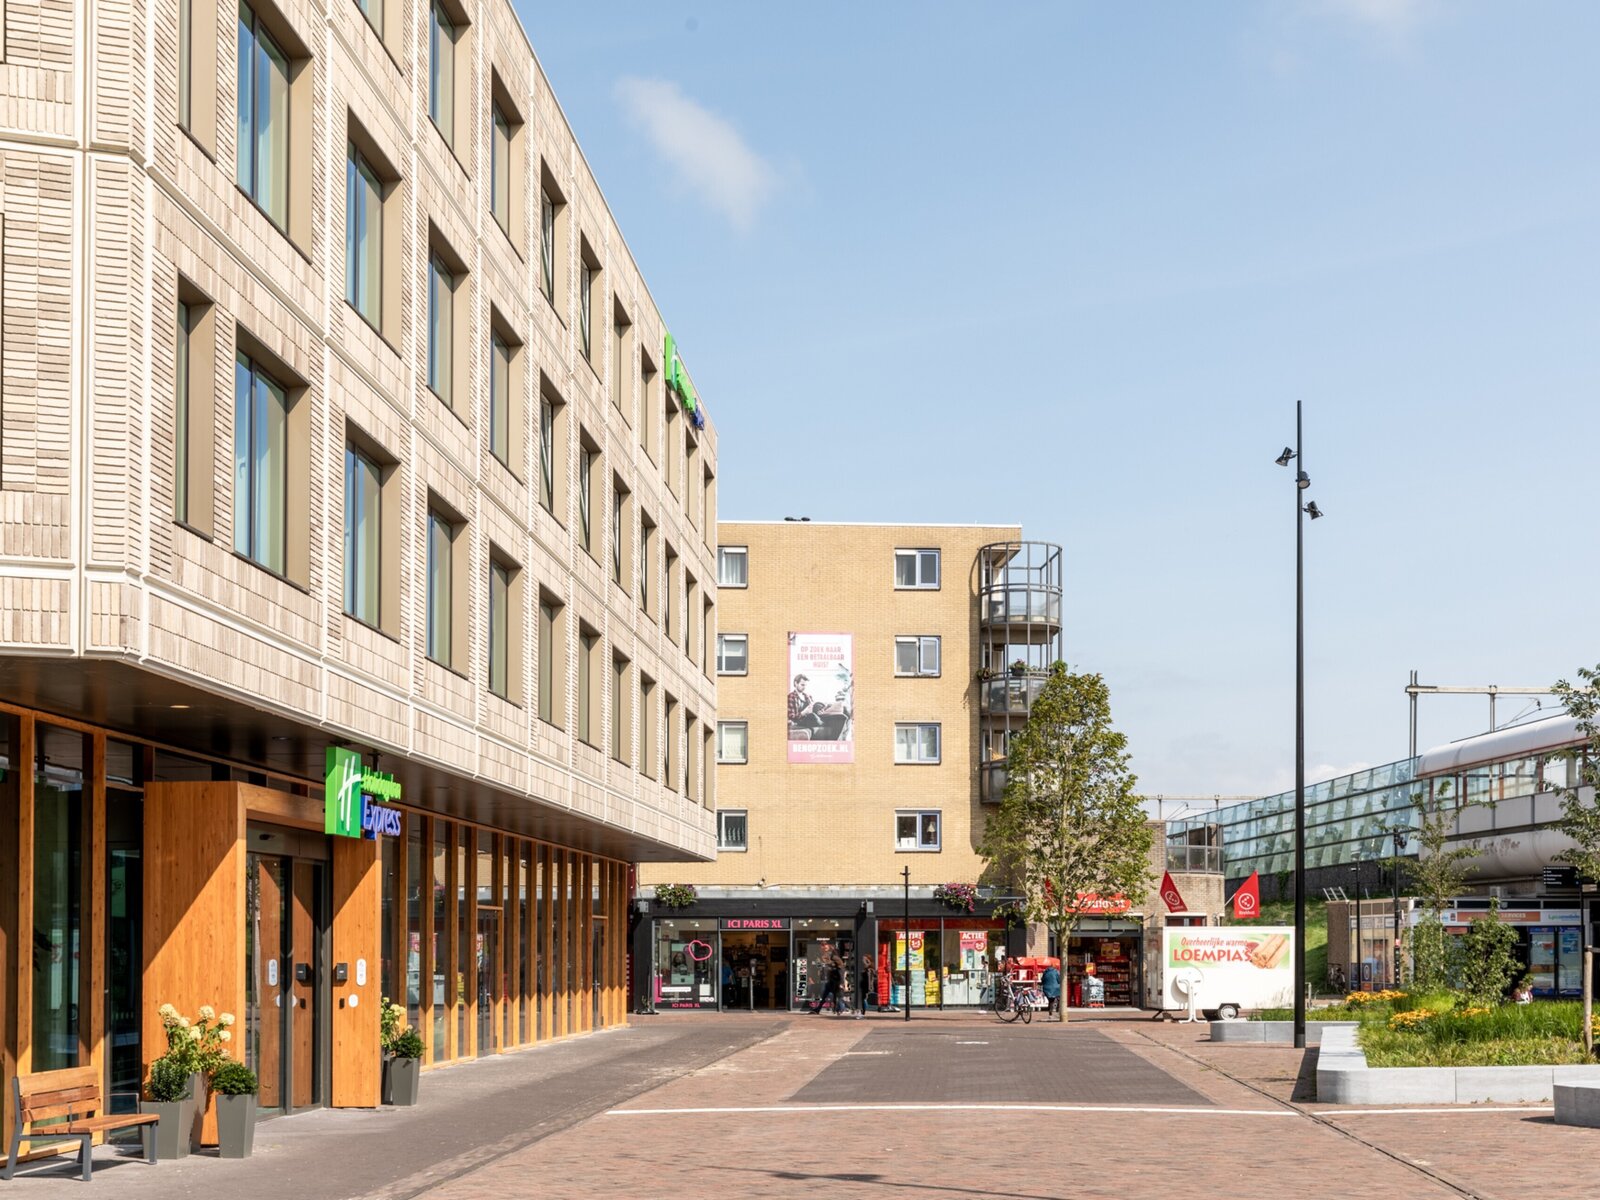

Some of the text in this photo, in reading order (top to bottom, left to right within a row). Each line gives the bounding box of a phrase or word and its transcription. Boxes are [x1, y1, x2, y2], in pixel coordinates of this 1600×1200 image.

[363, 795, 402, 840] Express
[727, 919, 783, 929] ICI PARIS XL
[1181, 936, 1225, 948] Overheerlijke
[1173, 949, 1252, 961] LOEMPIA'S
